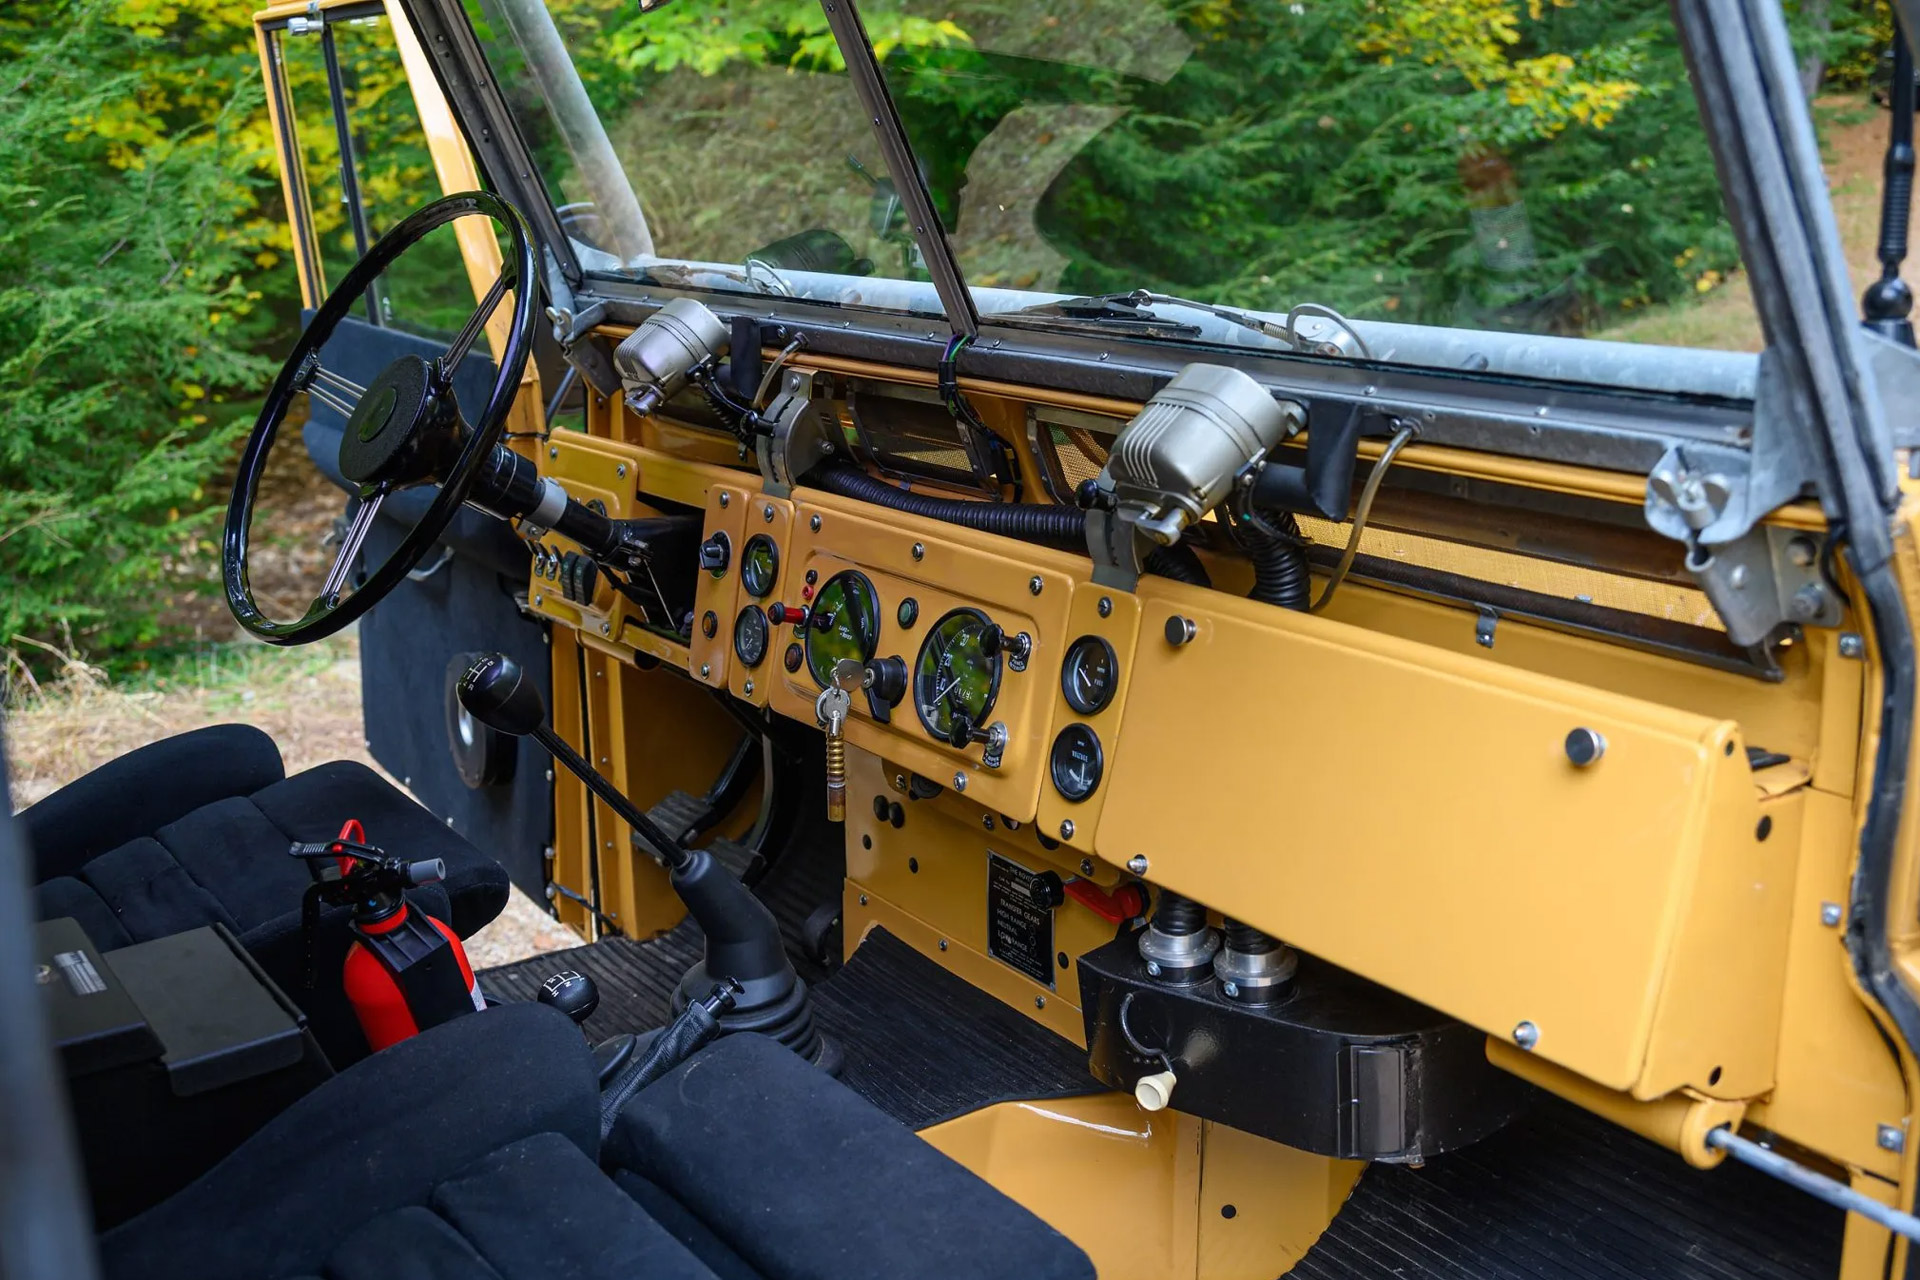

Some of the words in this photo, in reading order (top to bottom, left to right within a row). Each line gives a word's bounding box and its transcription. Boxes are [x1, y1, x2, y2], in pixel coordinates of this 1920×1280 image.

[468, 683, 475, 691] R
[1000, 898, 1023, 916] TRANSFER
[1023, 911, 1040, 926] GEARS
[1010, 915, 1027, 930] RANGE
[551, 989, 559, 997] H
